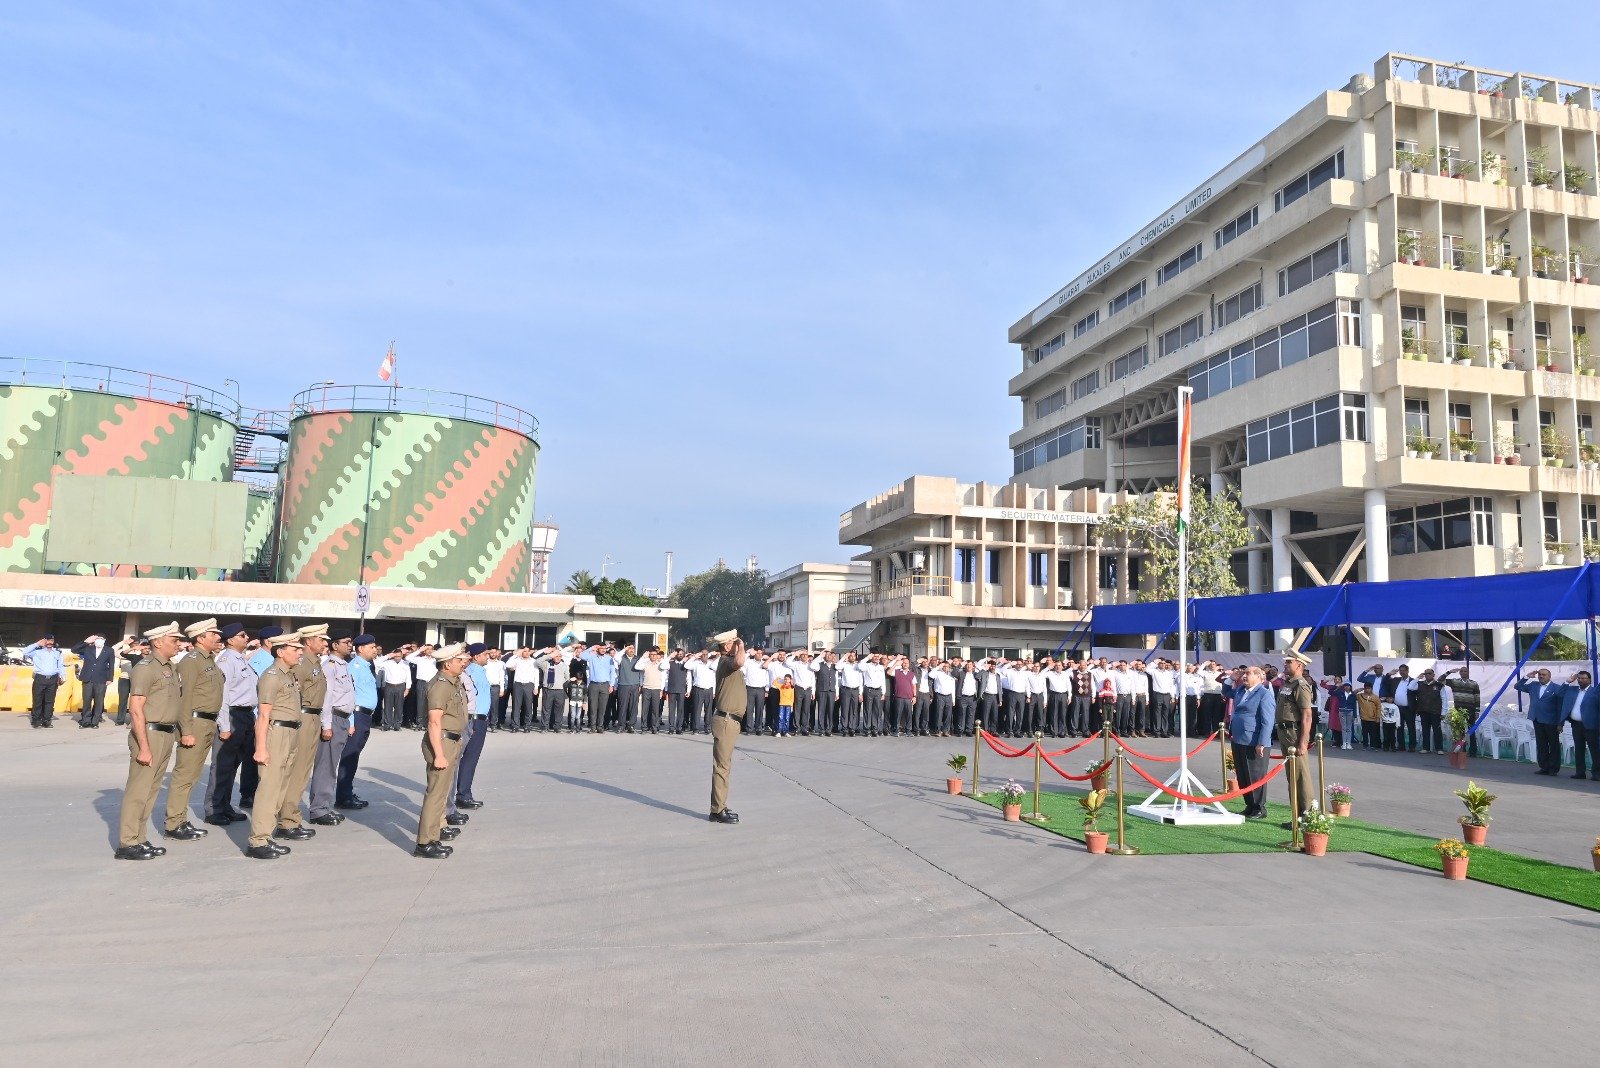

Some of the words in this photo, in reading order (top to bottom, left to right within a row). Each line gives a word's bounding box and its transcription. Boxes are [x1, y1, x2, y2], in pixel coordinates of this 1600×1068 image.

[1140, 214, 1175, 246] CHEMICALS
[1185, 187, 1212, 214] LIMITED
[25, 594, 101, 608] EMPLOYEES
[105, 597, 162, 610] SCOOTER
[172, 600, 251, 613] MOTORCYCLE
[257, 602, 308, 615] PARKING
